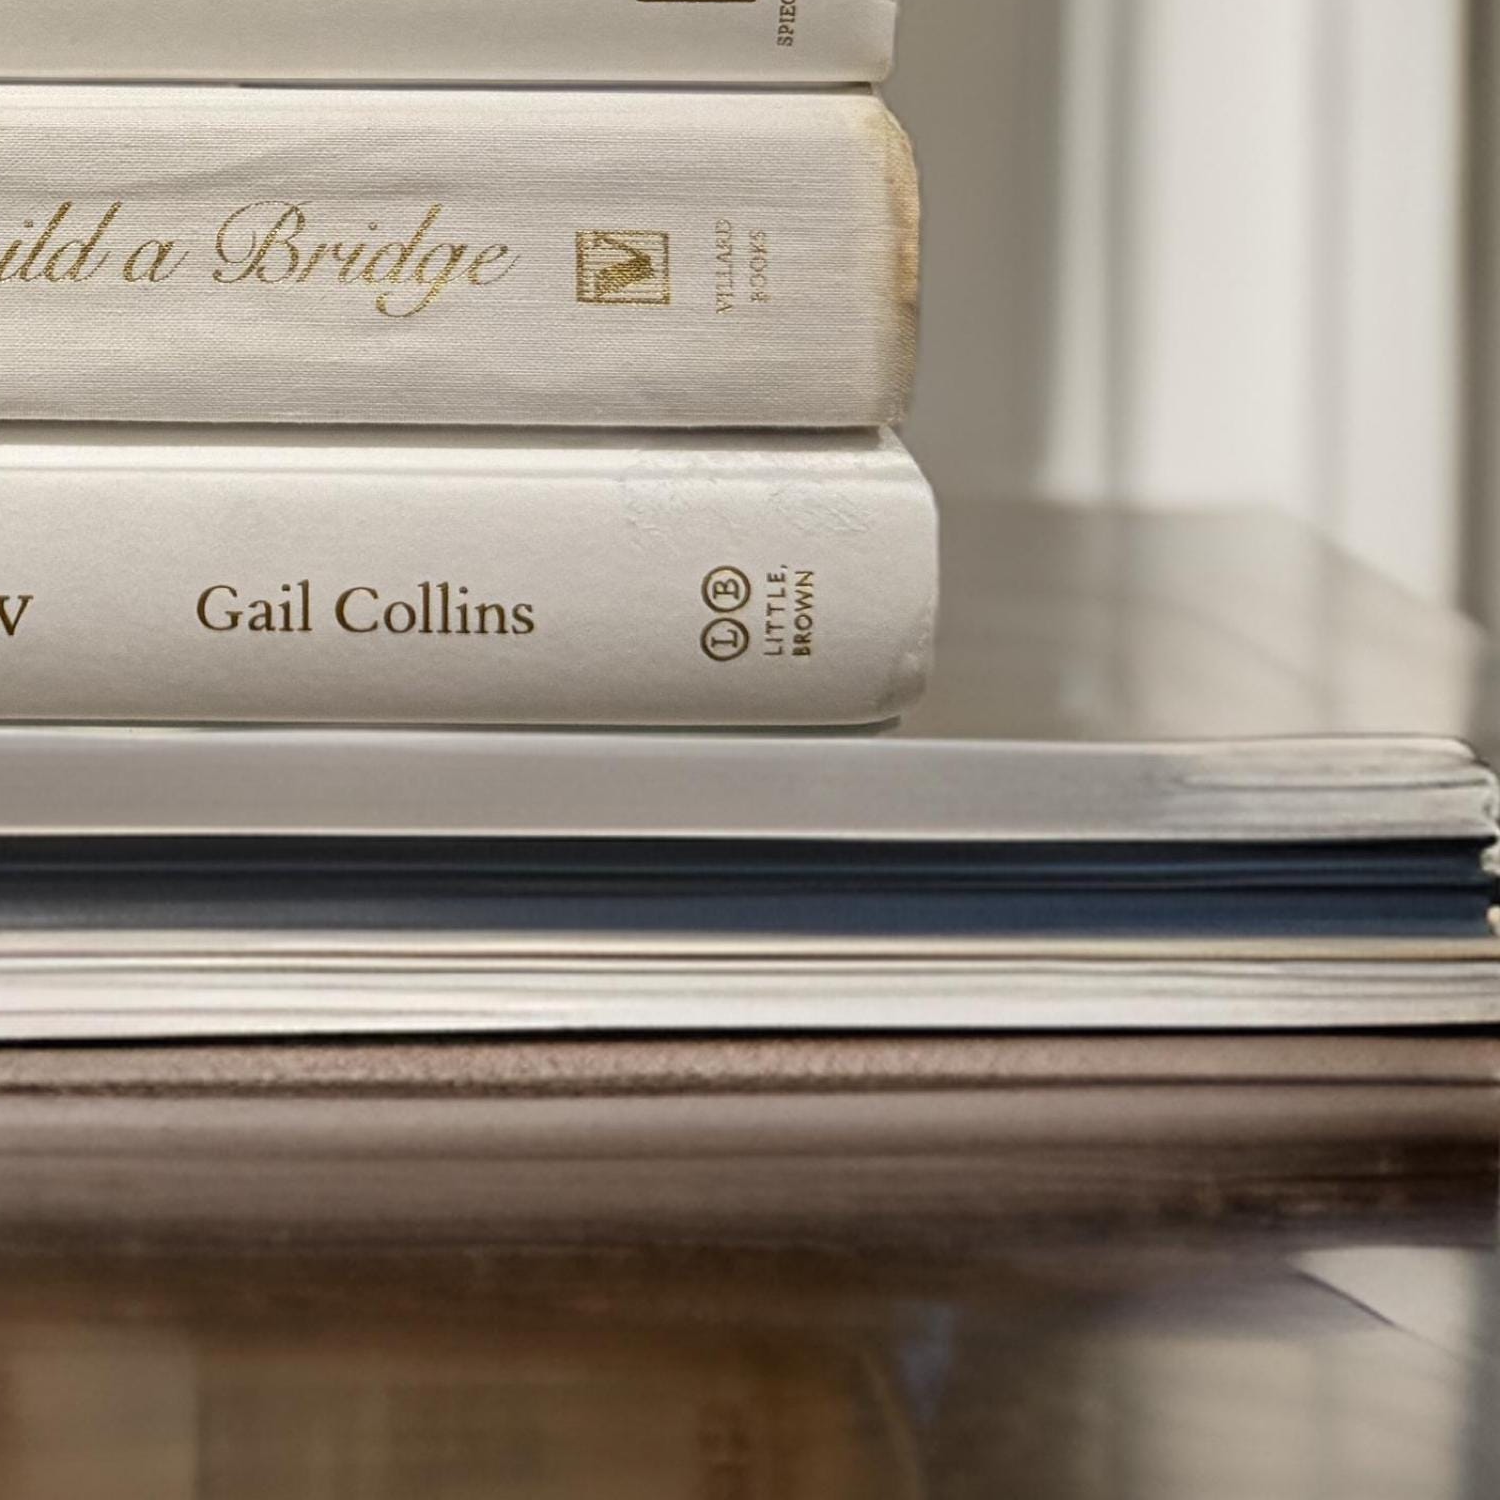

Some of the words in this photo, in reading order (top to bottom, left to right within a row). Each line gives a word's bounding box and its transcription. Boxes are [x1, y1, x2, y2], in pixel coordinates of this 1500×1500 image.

[121, 238, 190, 283] a
[211, 200, 522, 318] Bridge
[715, 219, 733, 314] VILLARD
[196, 580, 312, 632] Gail
[334, 581, 535, 635] Collins
[763, 564, 788, 656] LITTLE,
[791, 570, 815, 656] BROWN
